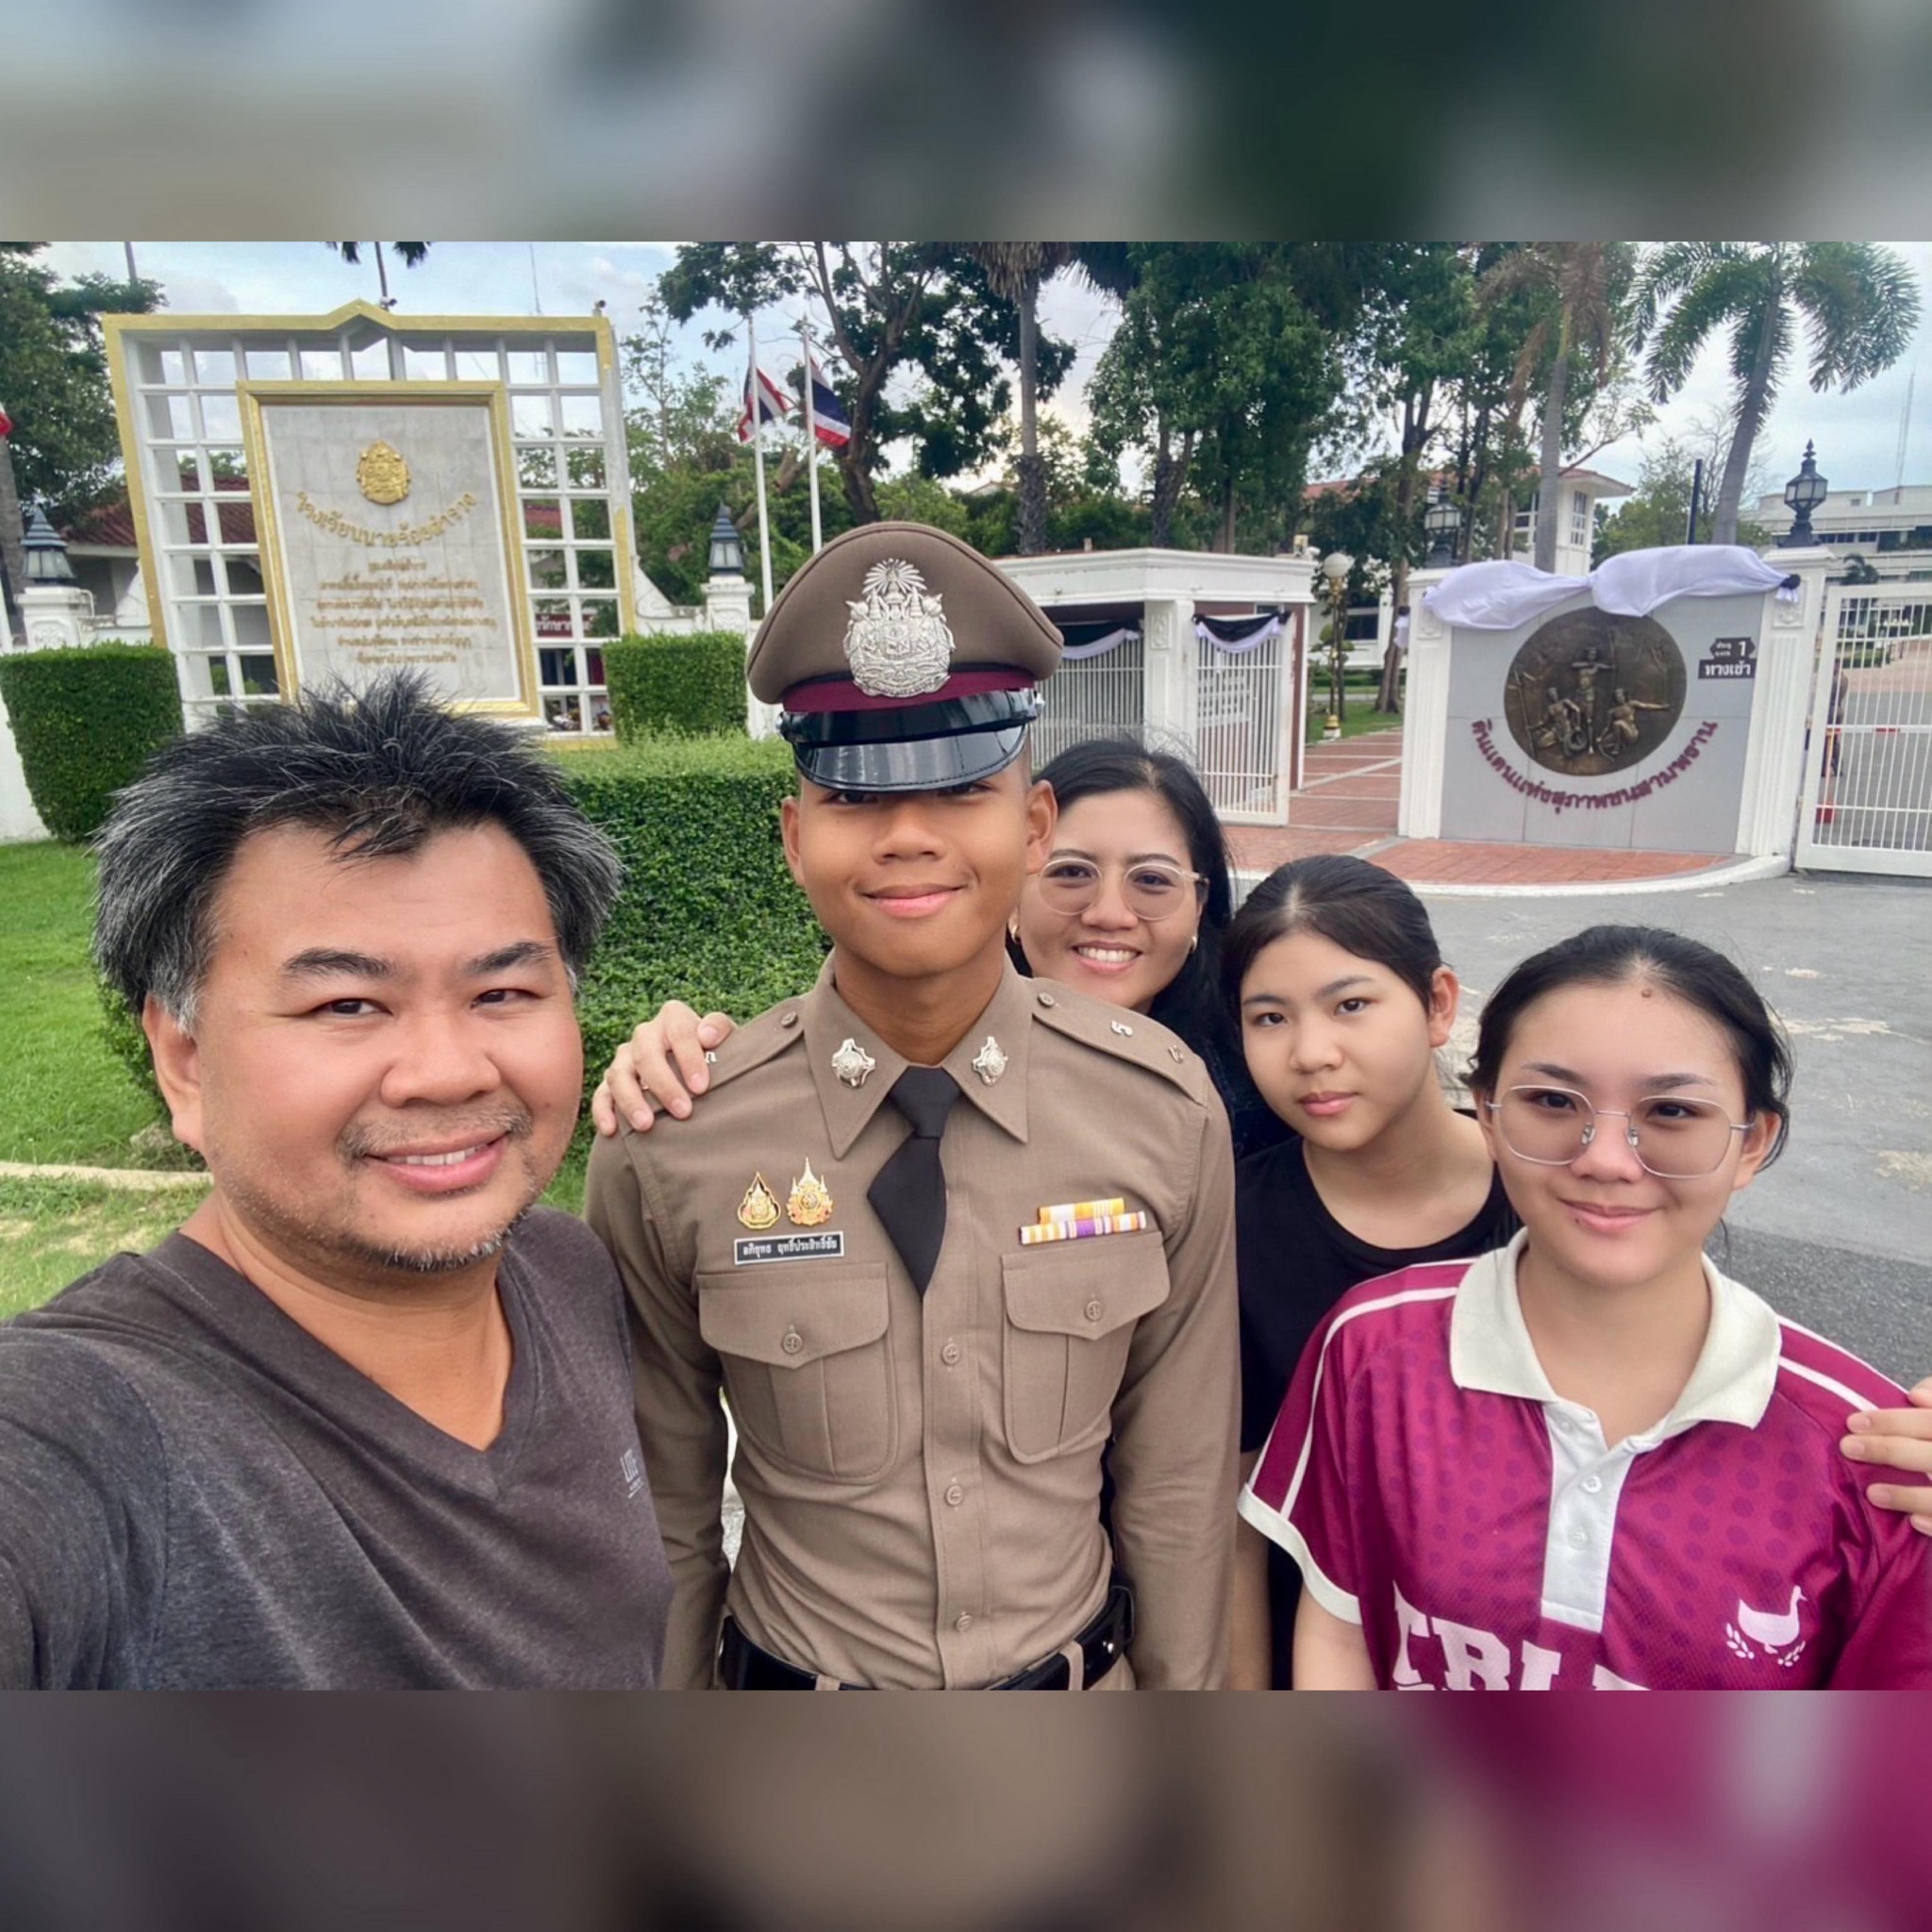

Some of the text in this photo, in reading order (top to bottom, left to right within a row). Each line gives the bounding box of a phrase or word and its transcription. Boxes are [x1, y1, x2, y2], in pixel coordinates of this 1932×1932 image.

[1739, 641, 1747, 657] 1
[1705, 660, 1752, 676] ทางเข้า
